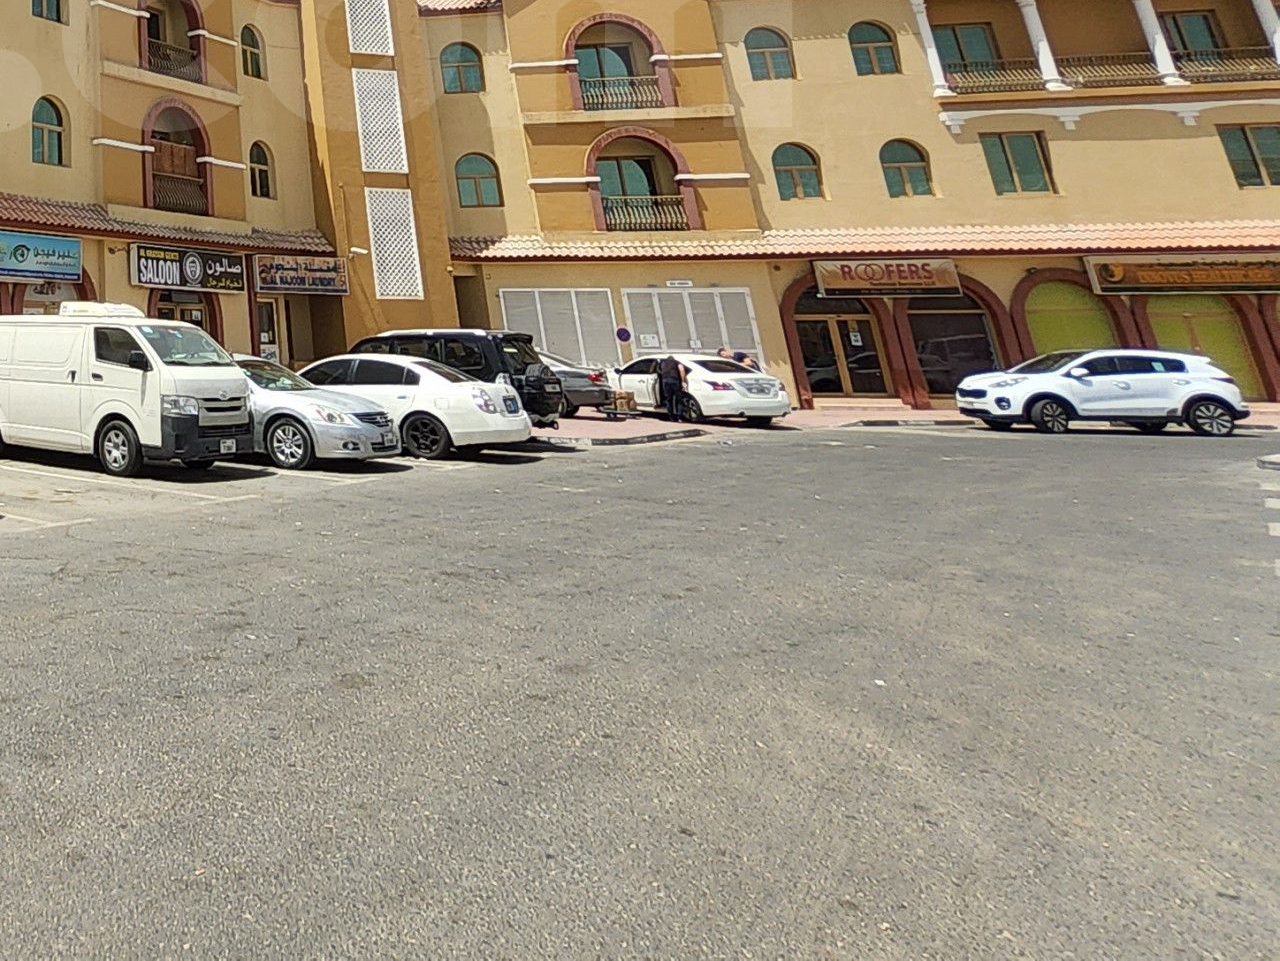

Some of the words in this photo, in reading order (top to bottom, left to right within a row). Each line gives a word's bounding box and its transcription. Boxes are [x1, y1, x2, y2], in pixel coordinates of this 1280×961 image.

[139, 257, 180, 285] SALOON
[206, 258, 242, 276] صالون
[840, 263, 934, 281] ROOFERS
